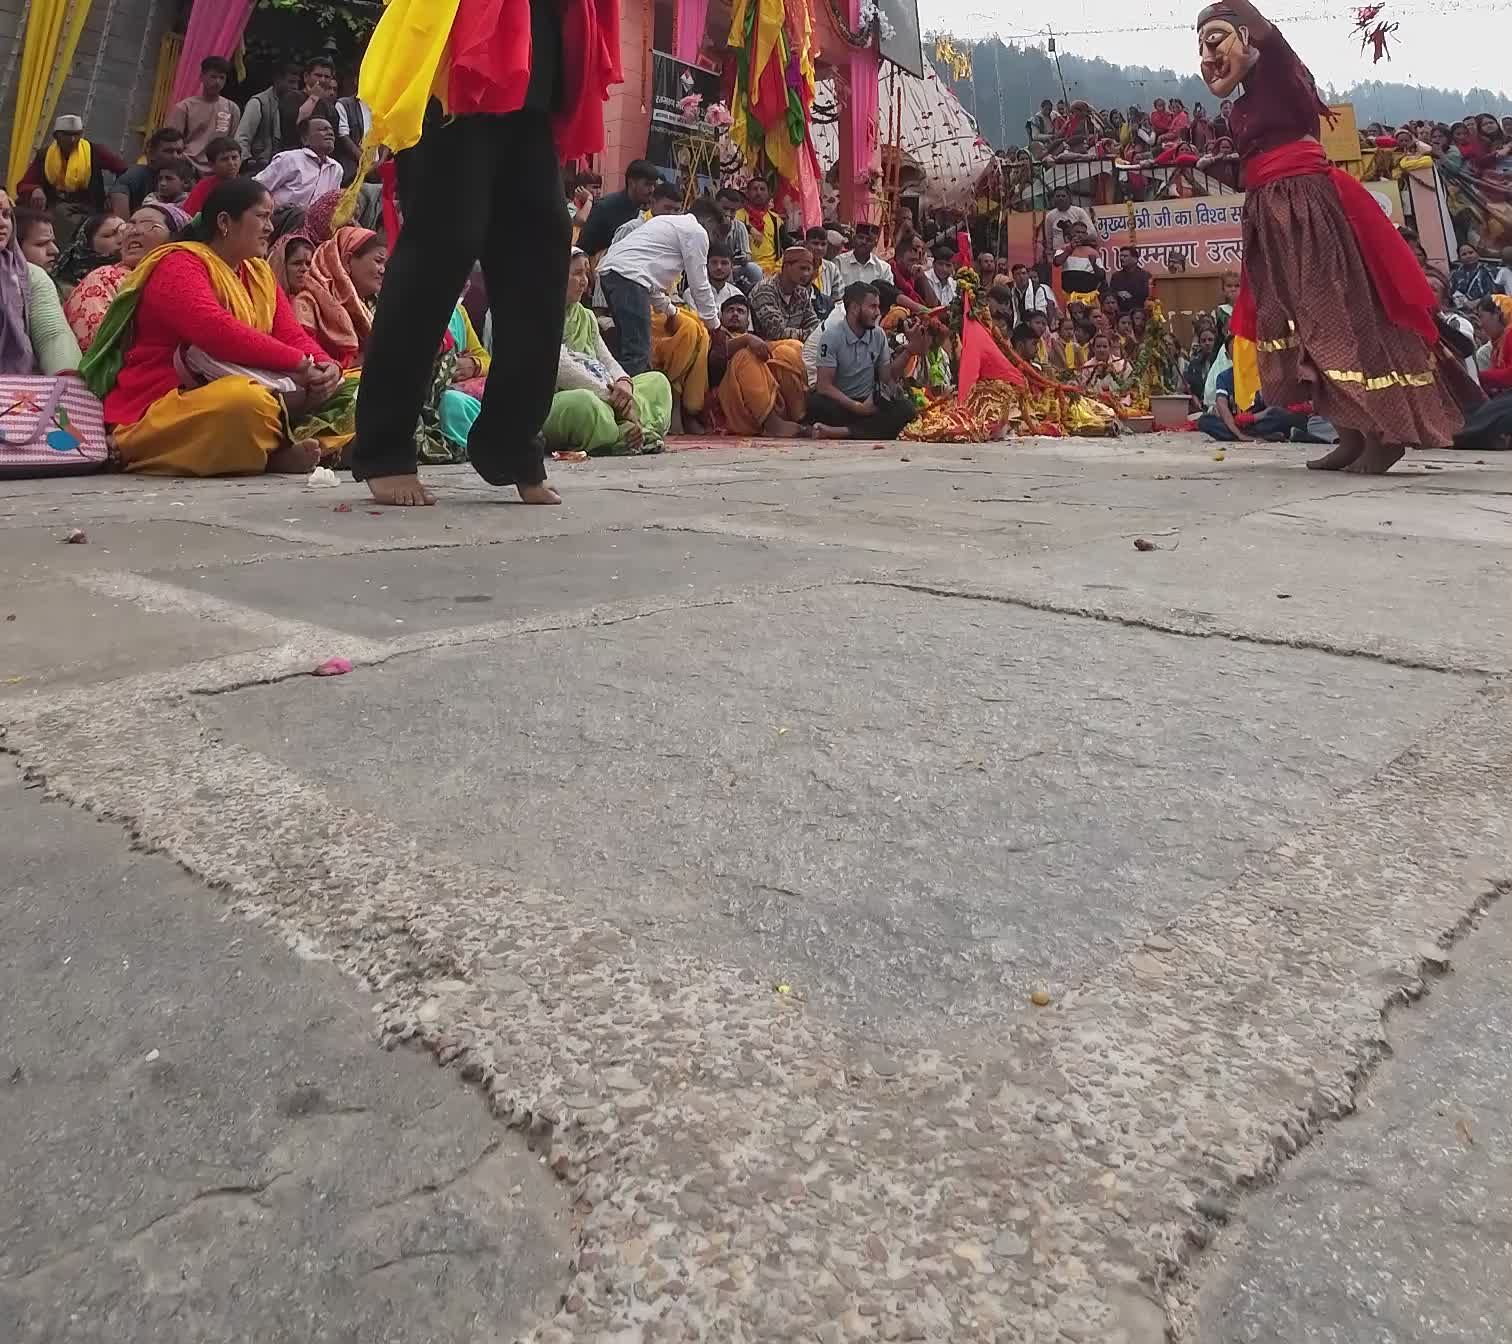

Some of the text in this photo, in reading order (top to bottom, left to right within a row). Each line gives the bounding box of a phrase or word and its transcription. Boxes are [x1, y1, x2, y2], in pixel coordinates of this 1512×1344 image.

[1097, 207, 1150, 239] मुख्यंत्री
[1154, 206, 1171, 227] जी
[1174, 210, 1192, 226] का
[1195, 202, 1227, 225] विश्व
